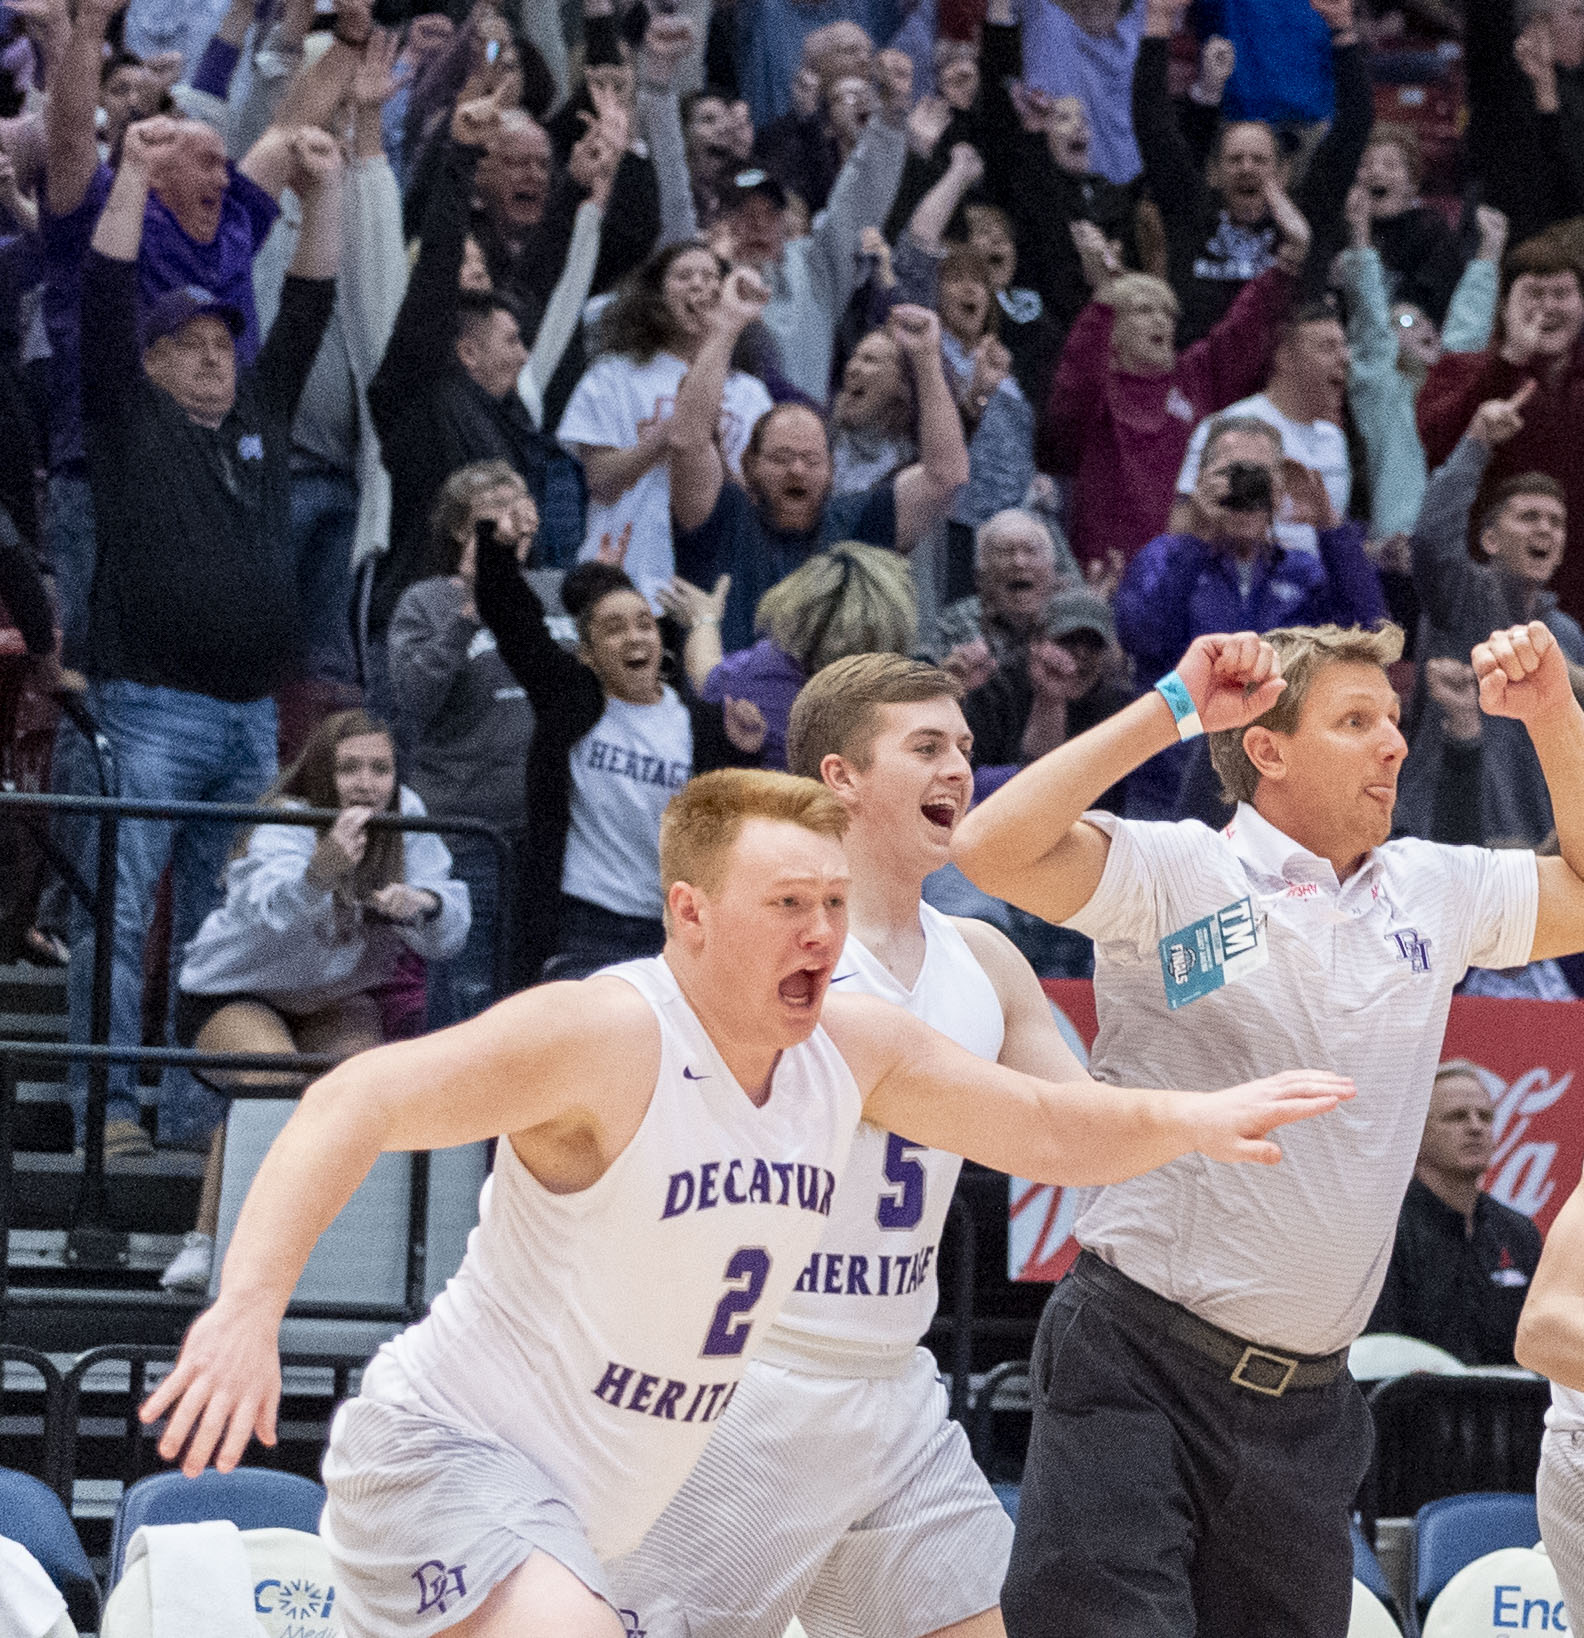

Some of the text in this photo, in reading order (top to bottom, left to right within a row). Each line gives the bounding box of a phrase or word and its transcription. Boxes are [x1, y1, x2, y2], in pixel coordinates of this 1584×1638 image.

[1218, 899, 1258, 957] TM
[656, 1156, 837, 1219] DECATUR
[874, 1132, 928, 1232] 5
[697, 1244, 774, 1361] 2
[792, 1245, 935, 1297] HERITAE
[590, 1360, 740, 1424] HERIT
